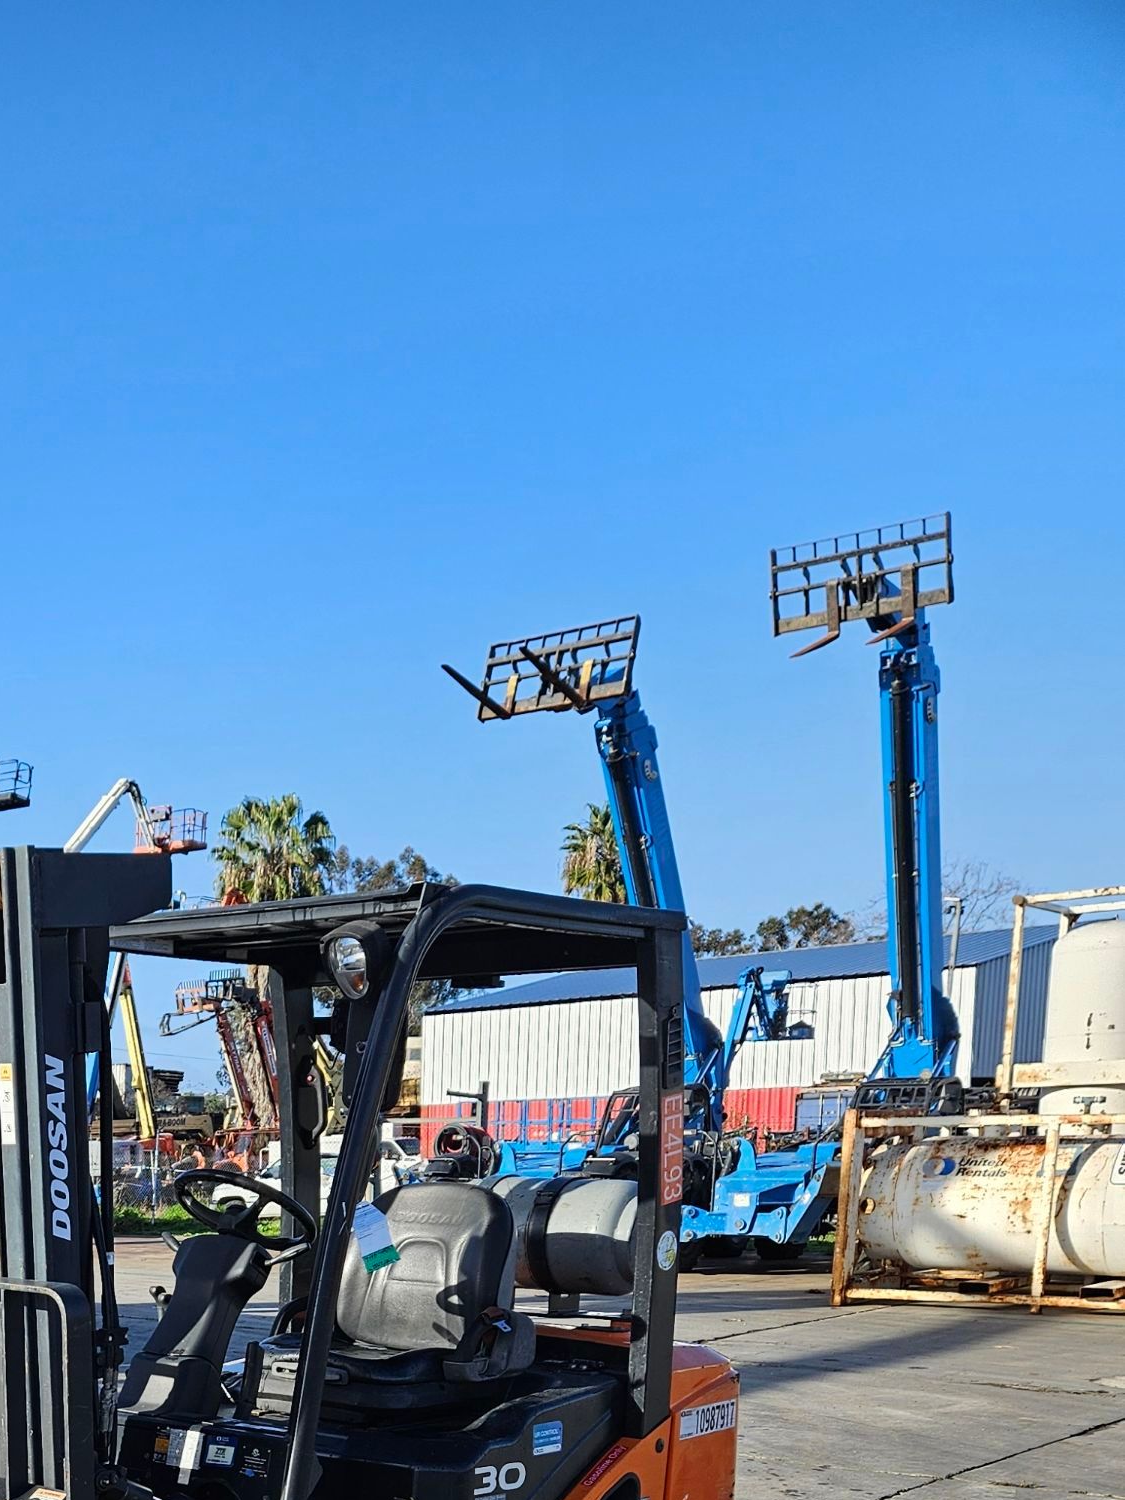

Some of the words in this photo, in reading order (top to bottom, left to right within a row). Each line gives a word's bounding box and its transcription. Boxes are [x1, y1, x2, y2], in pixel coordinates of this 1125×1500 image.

[44, 1053, 72, 1241] DOOSAN
[663, 1094, 683, 1201] EE4L93
[958, 1156, 1006, 1167] United
[955, 1167, 1008, 1178] Rentals
[695, 1401, 735, 1435] 10987917
[473, 1461, 527, 1496] 30
[583, 1458, 613, 1486] Gasoline
